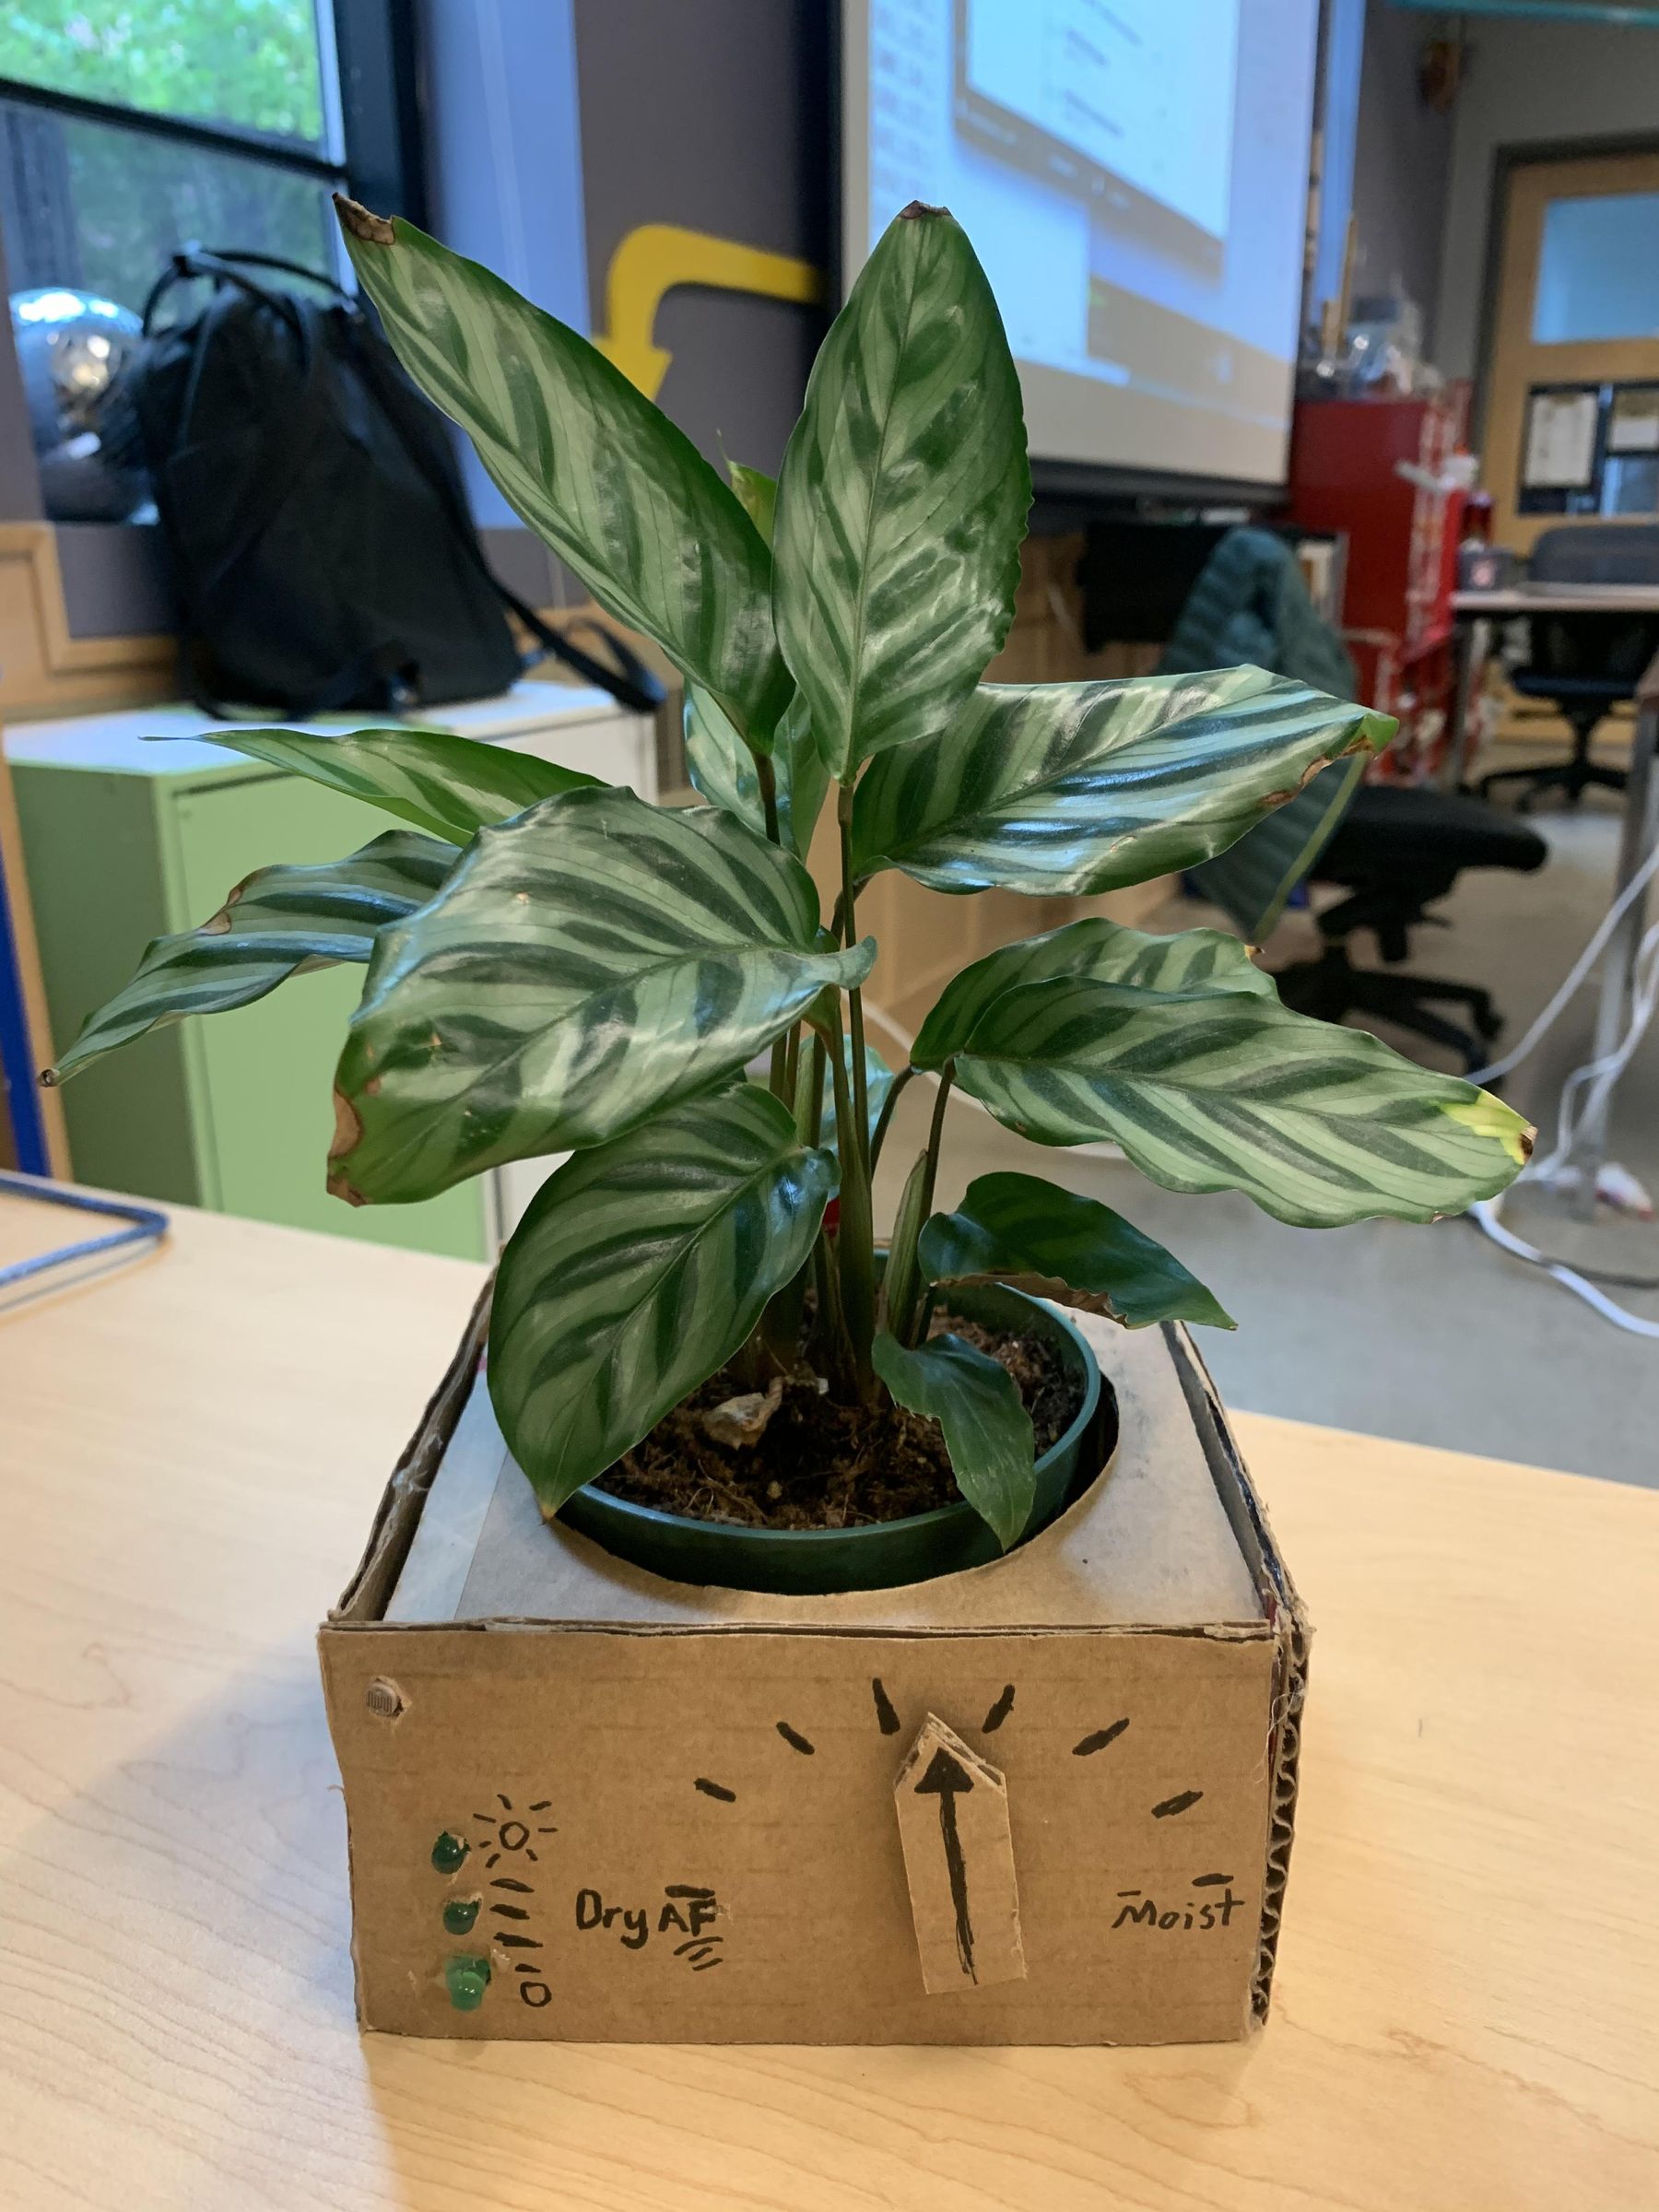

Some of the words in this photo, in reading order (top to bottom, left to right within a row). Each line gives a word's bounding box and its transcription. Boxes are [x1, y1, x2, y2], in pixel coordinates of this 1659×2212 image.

[576, 1888, 648, 1949] Dry
[658, 1899, 717, 1937] AF
[1112, 1888, 1246, 1930] Moist
